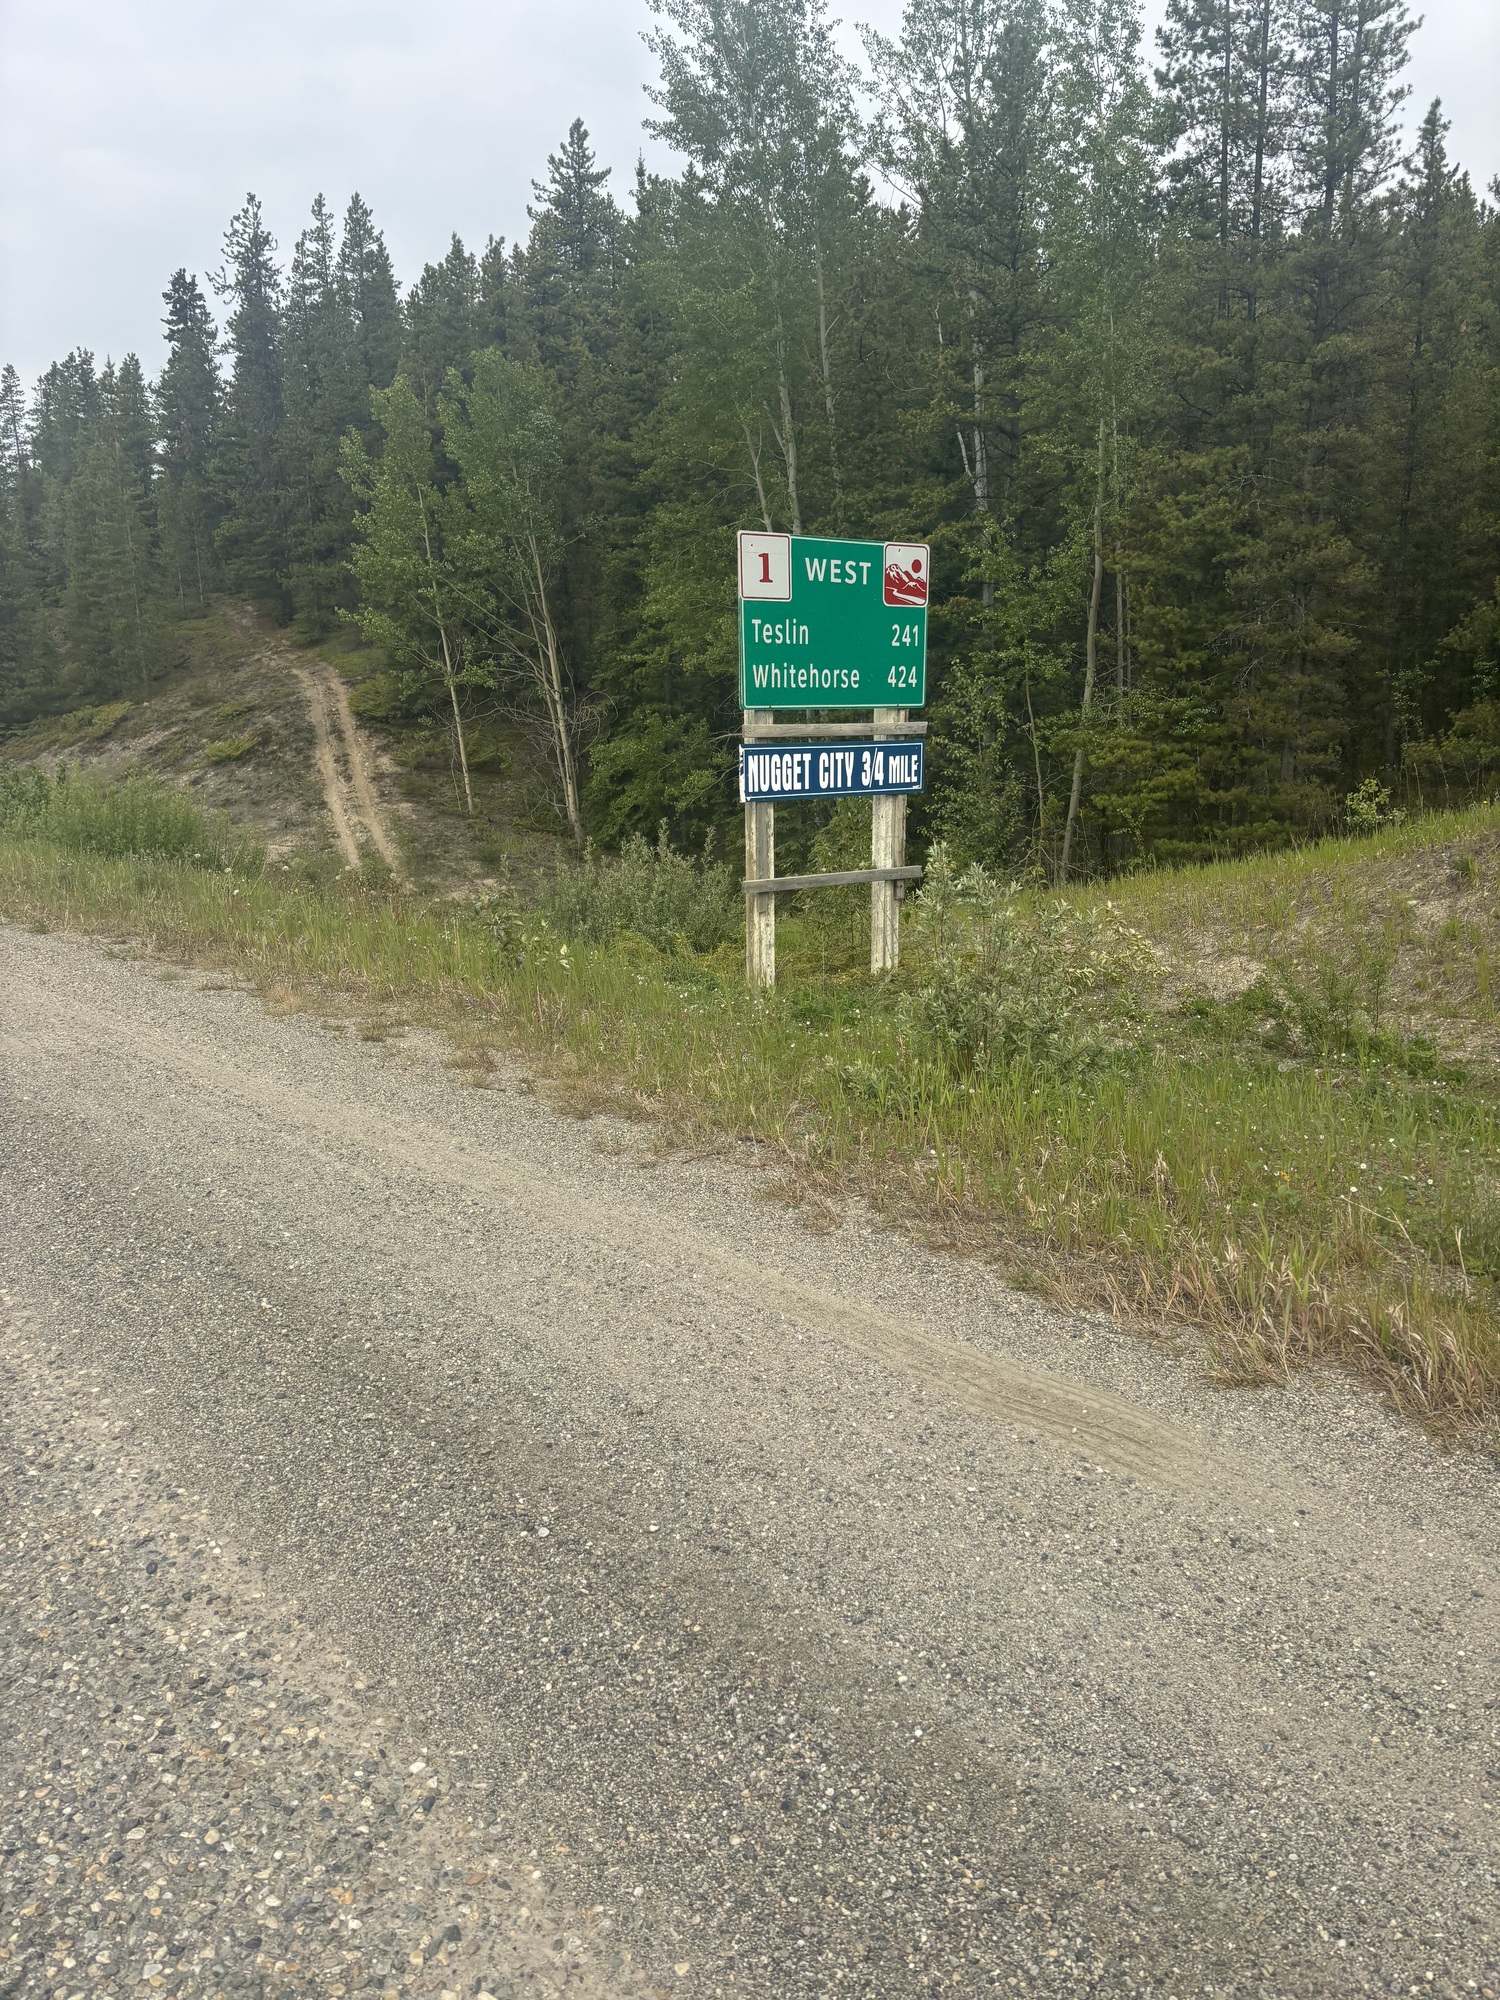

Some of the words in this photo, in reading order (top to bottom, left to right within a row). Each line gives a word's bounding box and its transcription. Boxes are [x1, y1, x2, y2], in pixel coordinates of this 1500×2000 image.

[758, 552, 774, 583] 1
[804, 557, 872, 585] WEST
[751, 618, 809, 645] Teslin
[891, 623, 919, 647] 241
[752, 661, 860, 689] Whitehorse
[887, 665, 917, 688] 424
[747, 753, 812, 793] NUGGET
[818, 751, 855, 789] CITY
[861, 747, 884, 788] 3/4
[888, 754, 919, 784] MILE
